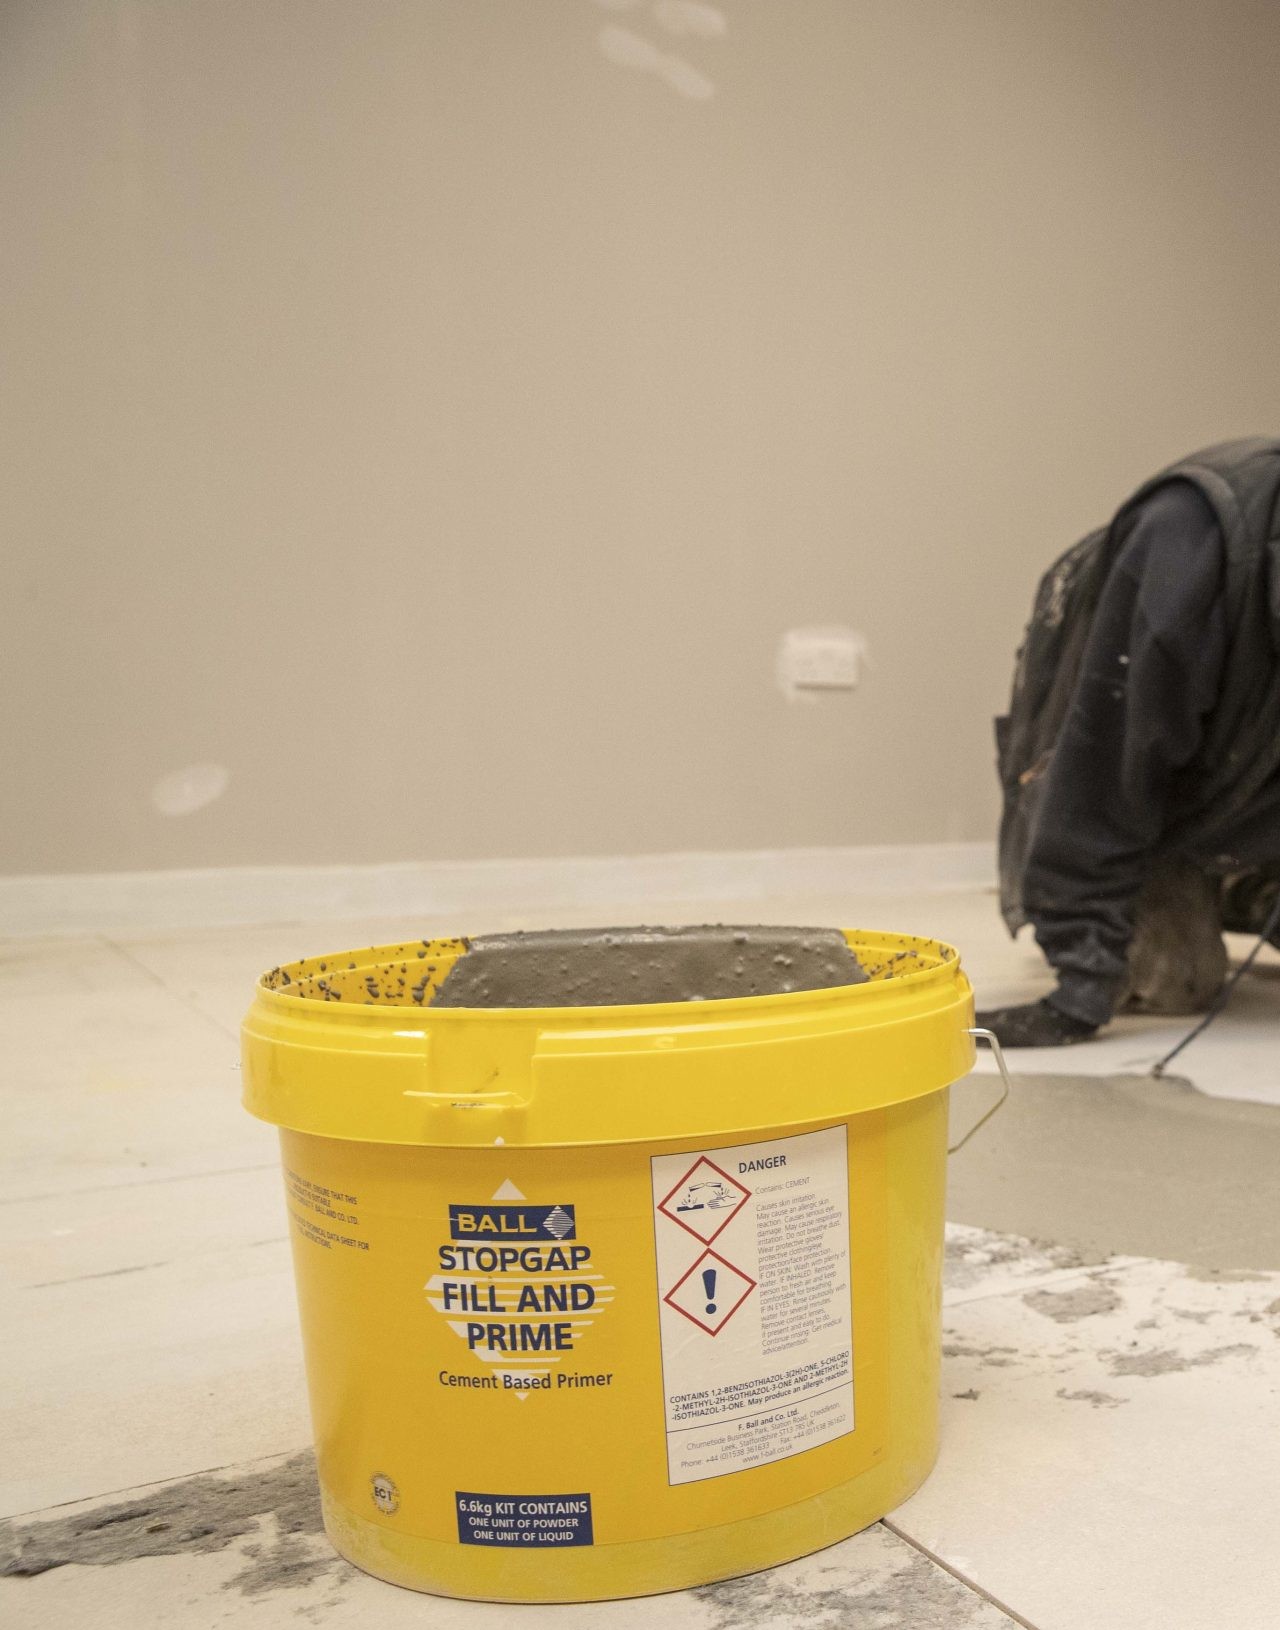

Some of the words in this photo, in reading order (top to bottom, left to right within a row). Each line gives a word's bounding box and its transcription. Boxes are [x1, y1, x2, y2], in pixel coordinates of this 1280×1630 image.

[739, 1155, 786, 1173] DANGER
[785, 1177, 810, 1188] CEMENT
[458, 1213, 537, 1233] BALL
[438, 1245, 591, 1273] STOPGAP
[443, 1282, 506, 1312] FILL
[517, 1283, 596, 1312] AND
[467, 1323, 574, 1351] PRIME
[439, 1371, 498, 1389] Cement
[503, 1374, 551, 1390] Based
[557, 1372, 613, 1389] Primer
[794, 1374, 808, 1385] AND
[670, 1391, 709, 1404] CONTAINS
[748, 1397, 763, 1406] May
[765, 1389, 791, 1403] produce
[802, 1378, 824, 1391] allergic
[746, 1420, 759, 1429] Ball
[761, 1416, 773, 1426] and
[775, 1413, 785, 1421] Co.
[787, 1408, 799, 1418] Ltd.
[459, 1500, 492, 1516] 6.6kg
[495, 1502, 515, 1514] KIT
[519, 1501, 587, 1515] CONTAINS
[468, 1517, 489, 1527] ONE
[491, 1518, 514, 1528] UNIT
[517, 1519, 531, 1528] OF
[533, 1518, 579, 1528] POWDER
[473, 1530, 494, 1540] ONE
[497, 1531, 520, 1541] UNIT
[522, 1532, 536, 1541] OF
[538, 1531, 574, 1542] LIQUID
